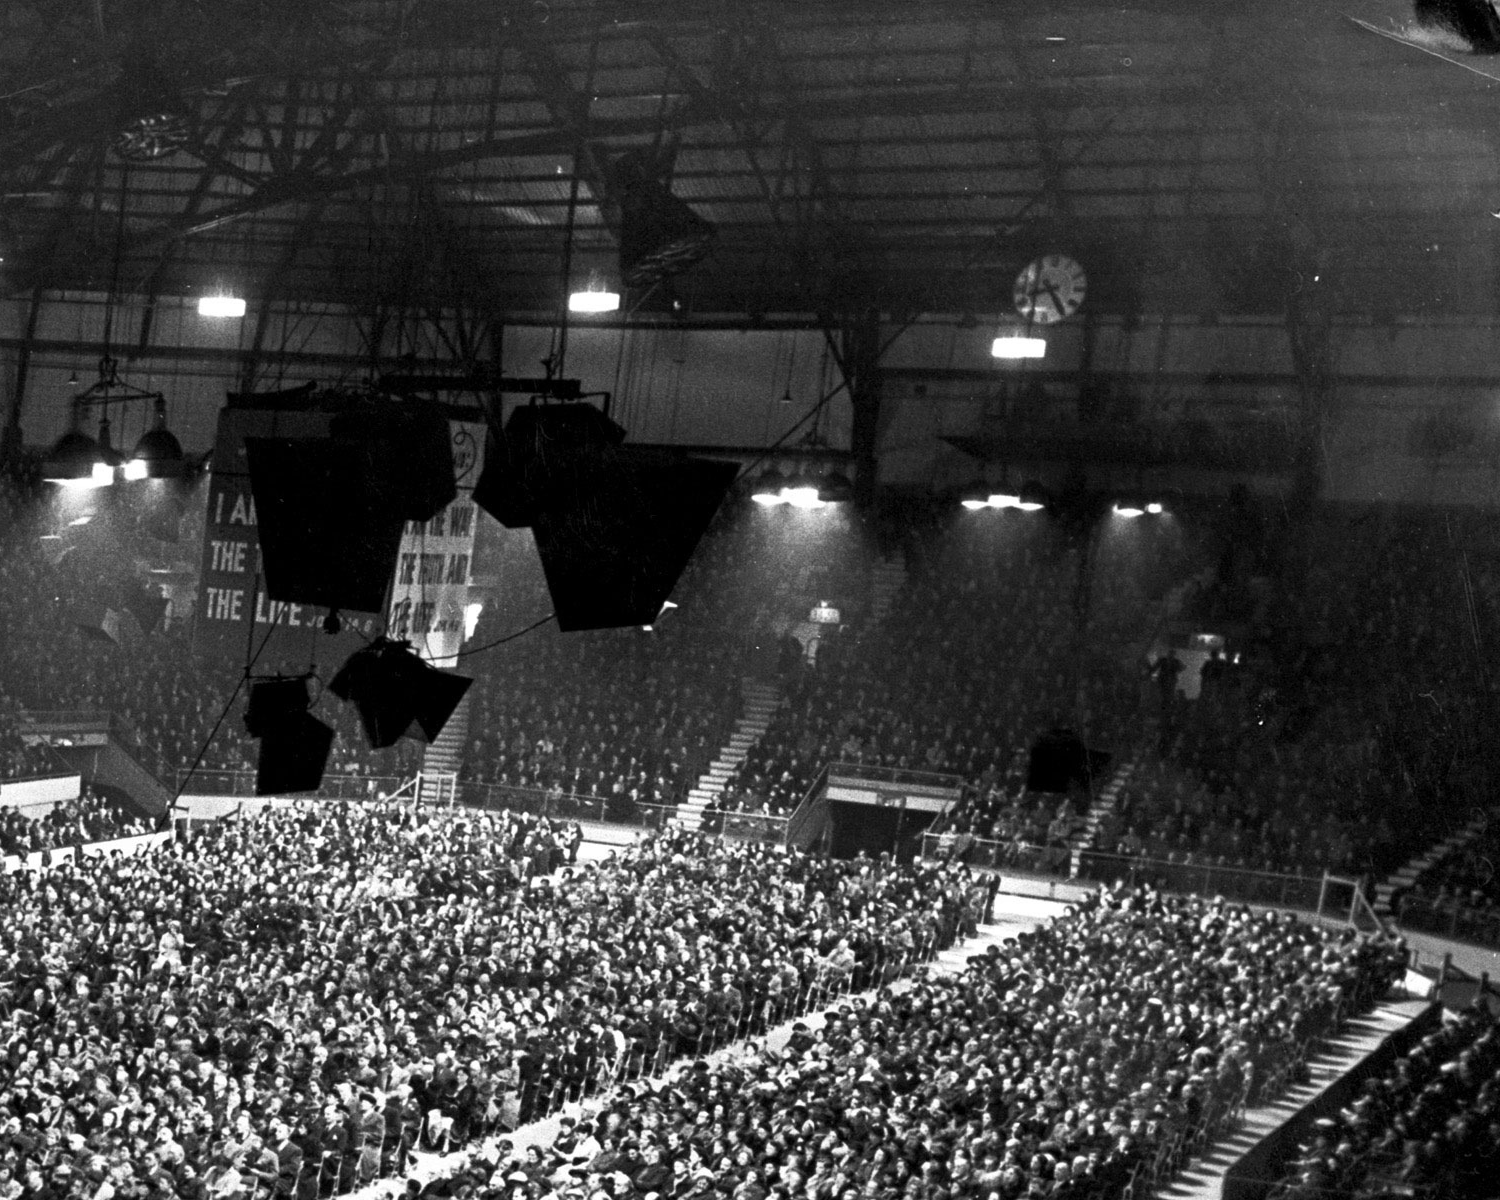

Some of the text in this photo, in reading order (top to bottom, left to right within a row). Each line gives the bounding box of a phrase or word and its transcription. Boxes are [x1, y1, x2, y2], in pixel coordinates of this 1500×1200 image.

[215, 493, 224, 524] I
[211, 540, 248, 572] THE
[207, 587, 244, 621] THE
[255, 592, 303, 626] LIFE
